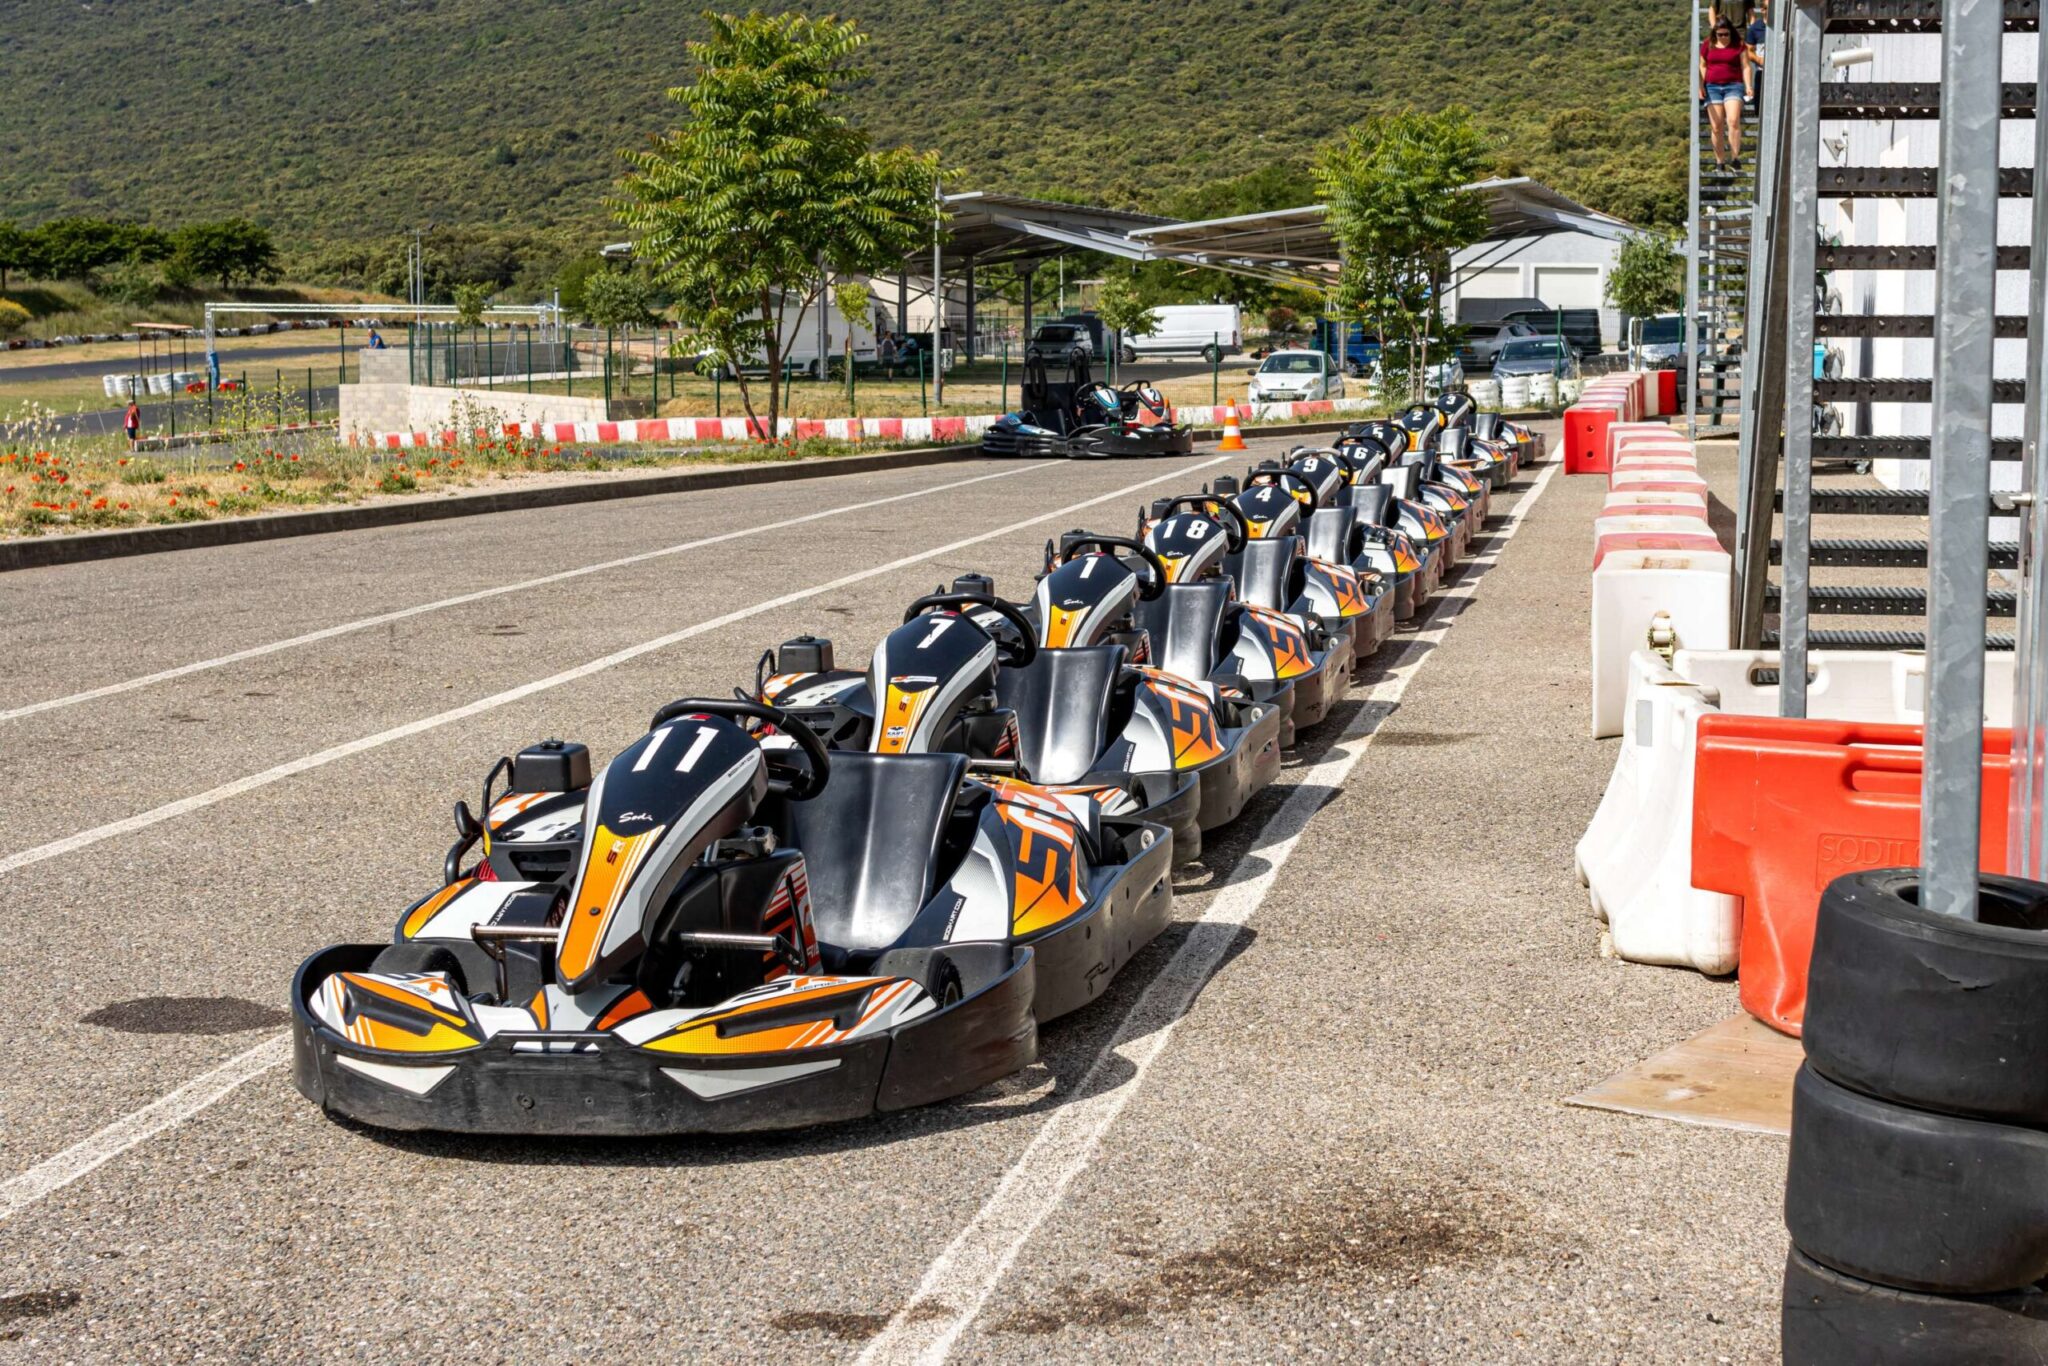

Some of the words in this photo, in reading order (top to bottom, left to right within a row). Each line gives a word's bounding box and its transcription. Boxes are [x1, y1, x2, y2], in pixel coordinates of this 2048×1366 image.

[1446, 396, 1456, 405] 3
[1412, 411, 1423, 421] 2
[1372, 427, 1385, 439] 5
[1342, 446, 1368, 460] 16
[1303, 458, 1319, 472] 9
[1255, 487, 1272, 502] 4
[1162, 519, 1210, 539] 18
[1079, 557, 1099, 579] 1
[916, 618, 956, 649] 7
[632, 726, 720, 773] 11
[618, 811, 653, 823] Sodi
